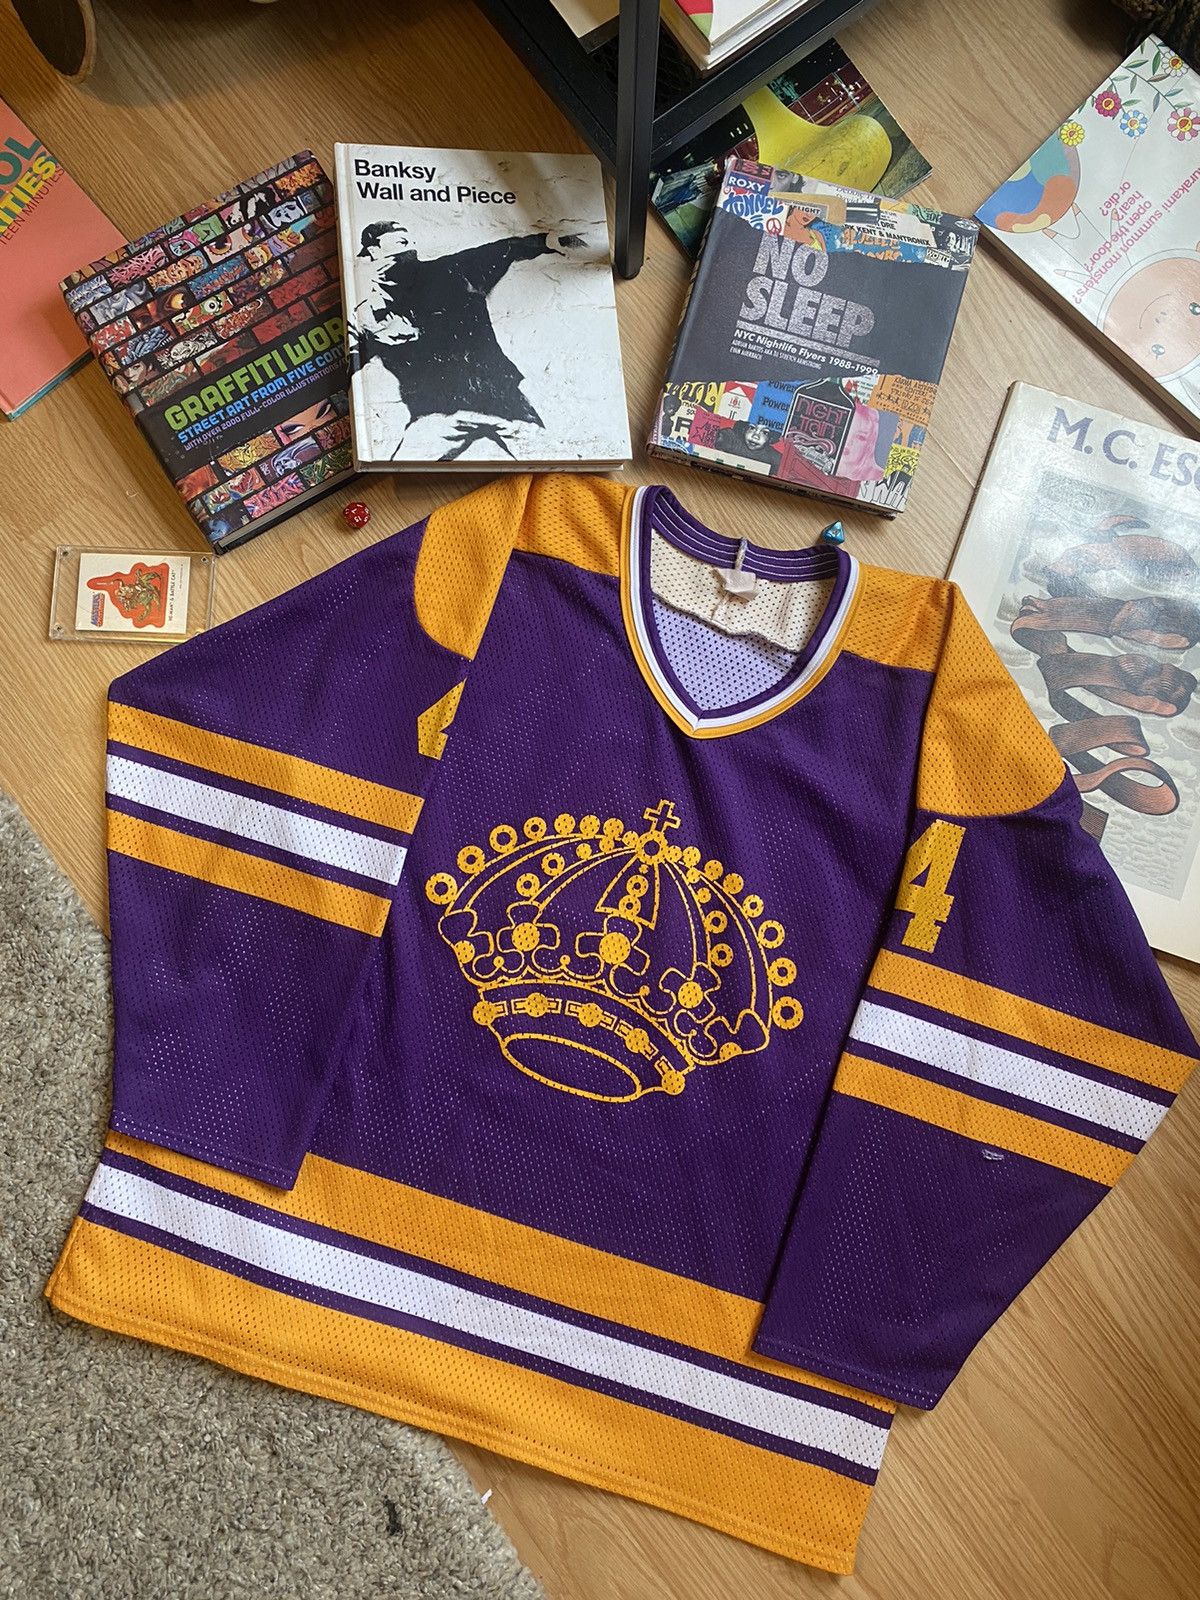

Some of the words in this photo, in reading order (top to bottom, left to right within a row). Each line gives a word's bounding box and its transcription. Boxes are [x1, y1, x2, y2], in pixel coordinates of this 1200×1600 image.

[0, 137, 42, 186] OL
[354, 159, 436, 183] Banksy
[728, 176, 765, 192] ROXY
[0, 153, 57, 234] ITIES
[22, 165, 65, 217] MINUTES
[356, 181, 403, 200] Wall
[410, 185, 450, 202] and
[456, 186, 516, 204] Piece
[1099, 192, 1120, 217] die?
[1117, 190, 1144, 221] heal?
[1120, 181, 1131, 195] or
[1162, 167, 1200, 212] urakami
[856, 225, 879, 236] KENT
[885, 231, 931, 246] MANTRONIX
[1110, 222, 1129, 242] the
[1120, 210, 1163, 253] summon
[1127, 200, 1152, 227] open
[753, 232, 829, 287] NO
[1072, 251, 1122, 304] monsters?
[1084, 240, 1112, 273] door?
[739, 276, 875, 349] SLEEP
[734, 329, 756, 342] NYC
[756, 335, 797, 354] Nightlife
[799, 347, 826, 363] Flyers
[829, 356, 879, 375] 1988-1999
[164, 350, 287, 431] GRAFFITI
[177, 408, 226, 443] STREET
[227, 395, 251, 418] ART
[251, 377, 288, 403] FROM
[289, 361, 316, 384] FIVE
[184, 435, 203, 450] WITH
[202, 426, 221, 442] OVER
[221, 415, 241, 432] 2000
[241, 391, 286, 423] FULL-COLOR
[1047, 406, 1093, 455] M.
[1102, 429, 1138, 470] C.
[895, 819, 966, 953] 4
